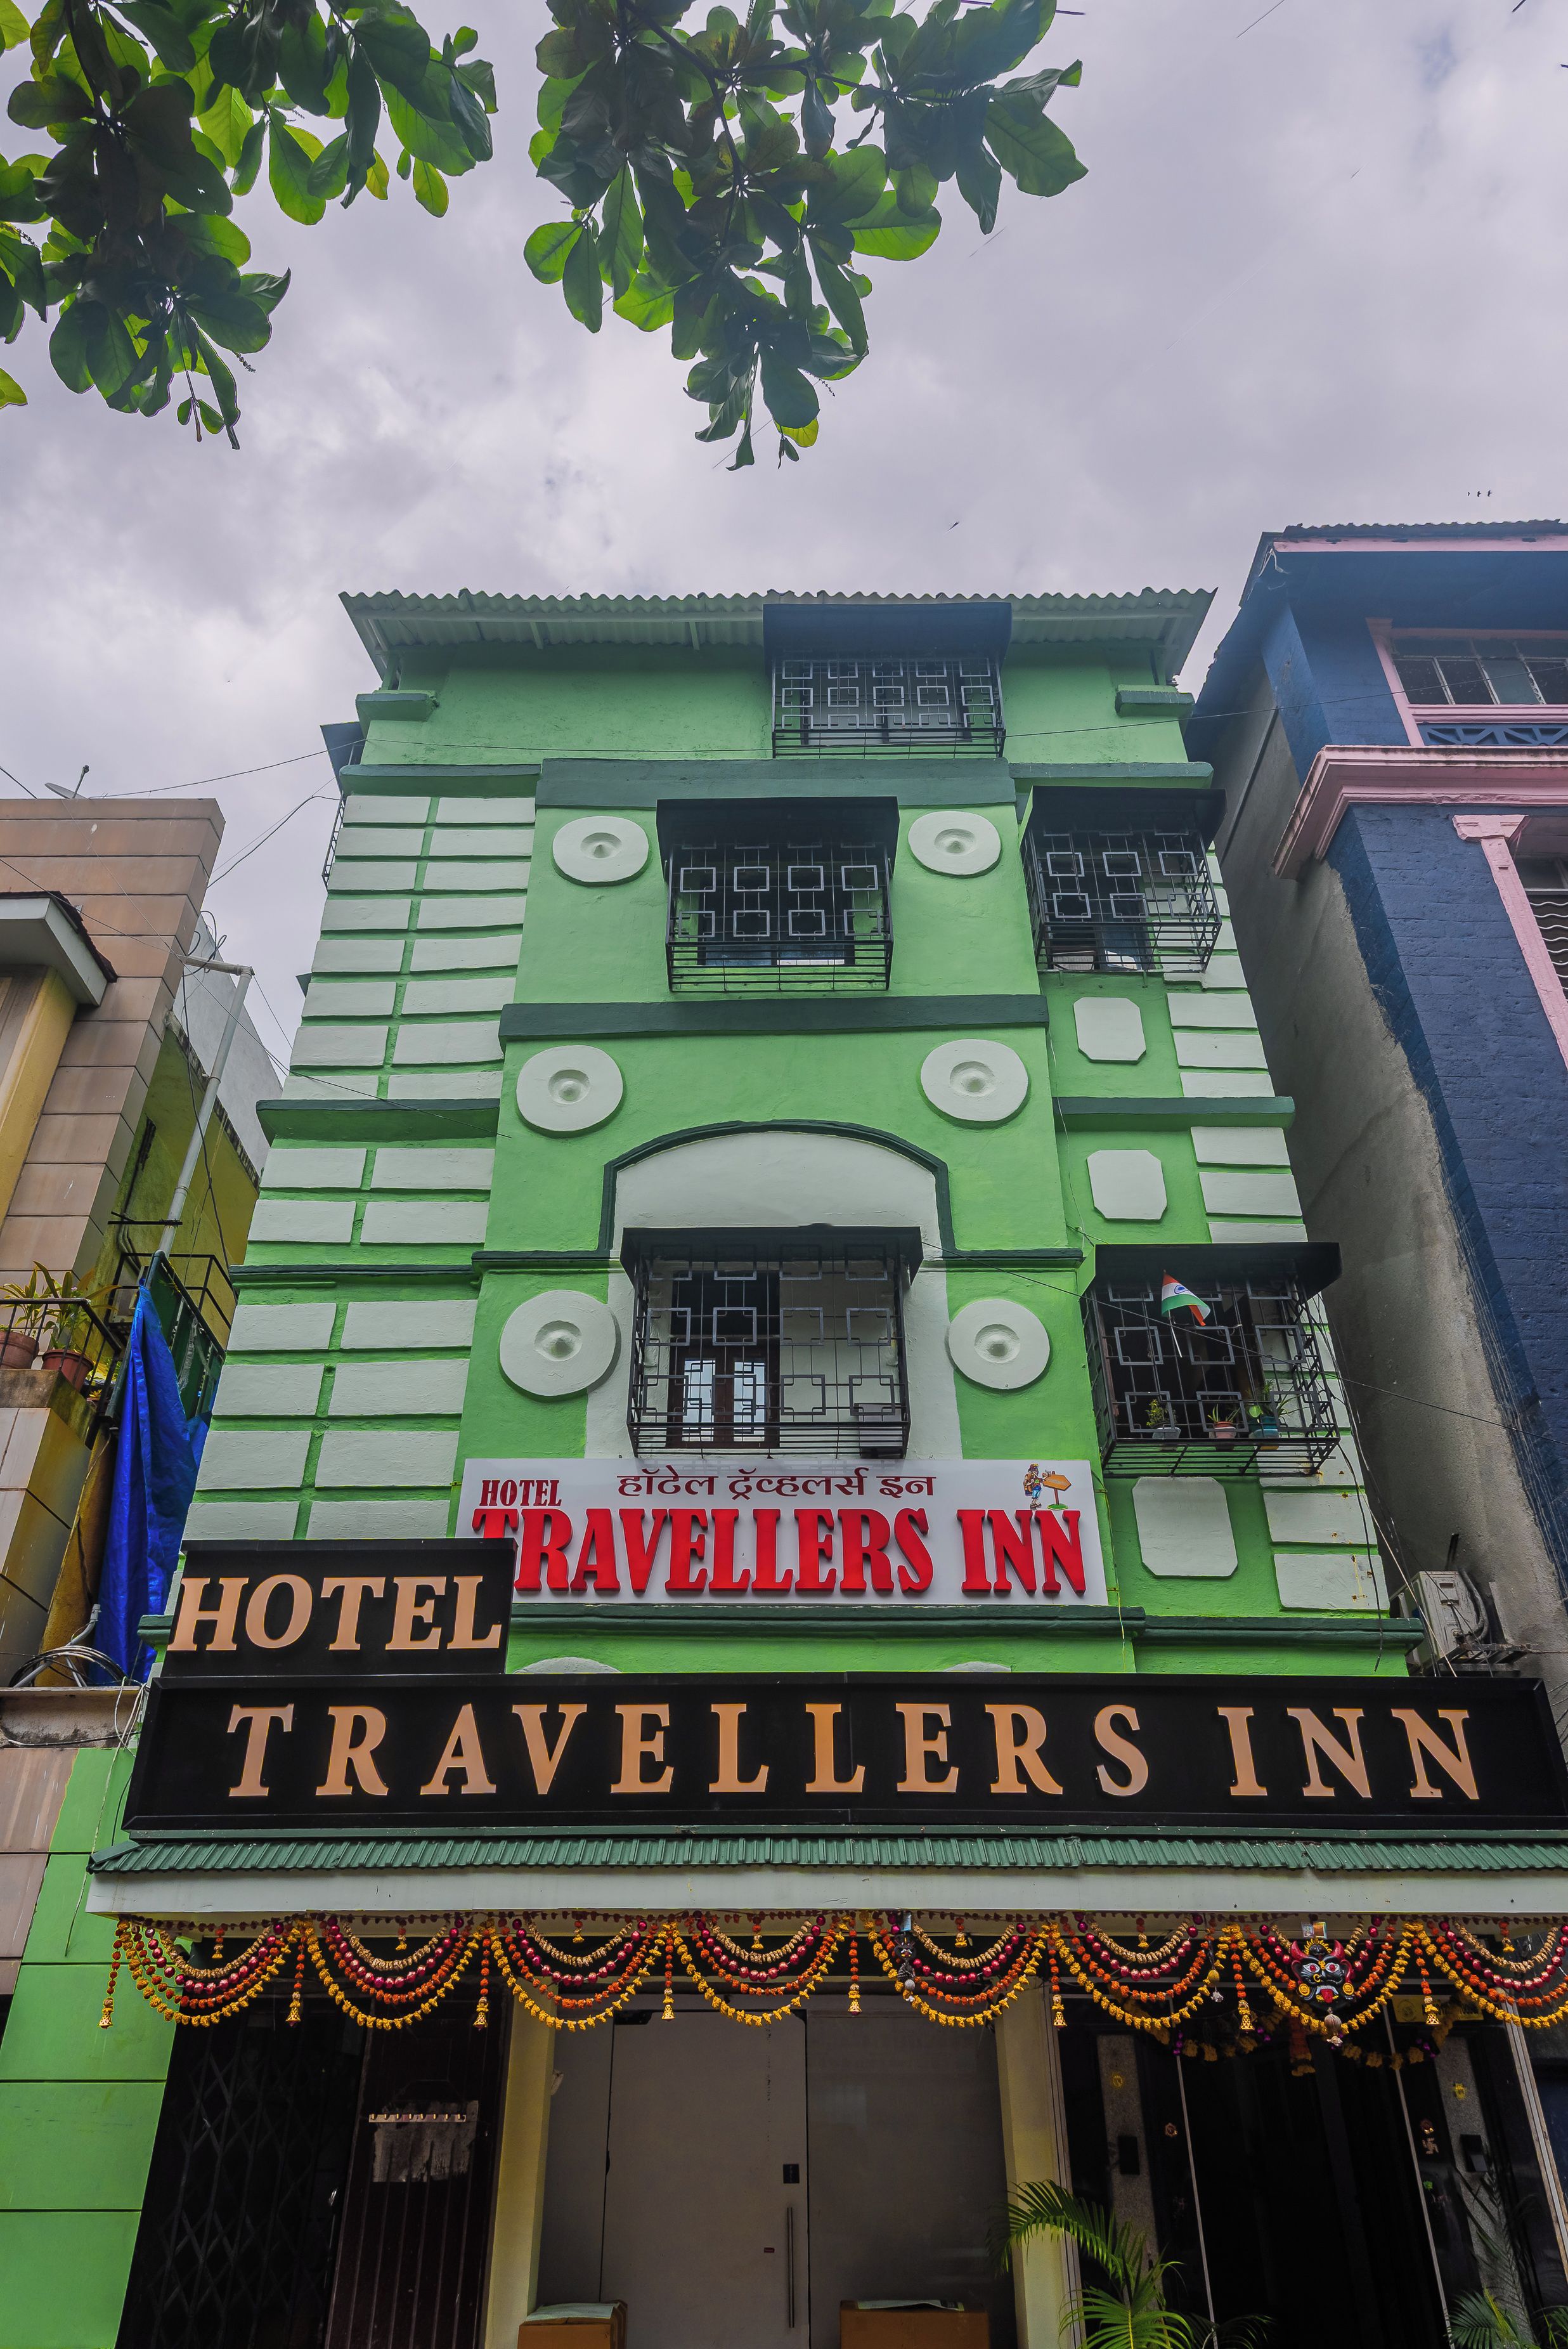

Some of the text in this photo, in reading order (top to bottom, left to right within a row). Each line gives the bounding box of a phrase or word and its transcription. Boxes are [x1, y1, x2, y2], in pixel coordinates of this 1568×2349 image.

[479, 1480, 562, 1506] HOTEL
[617, 1464, 937, 1500] हॉटेल ट्रॅव्हलर्स इन
[956, 1508, 1086, 1595] INN
[167, 1574, 502, 1651] HOTEL
[226, 1702, 1479, 1799] TRAVELLERS INN
